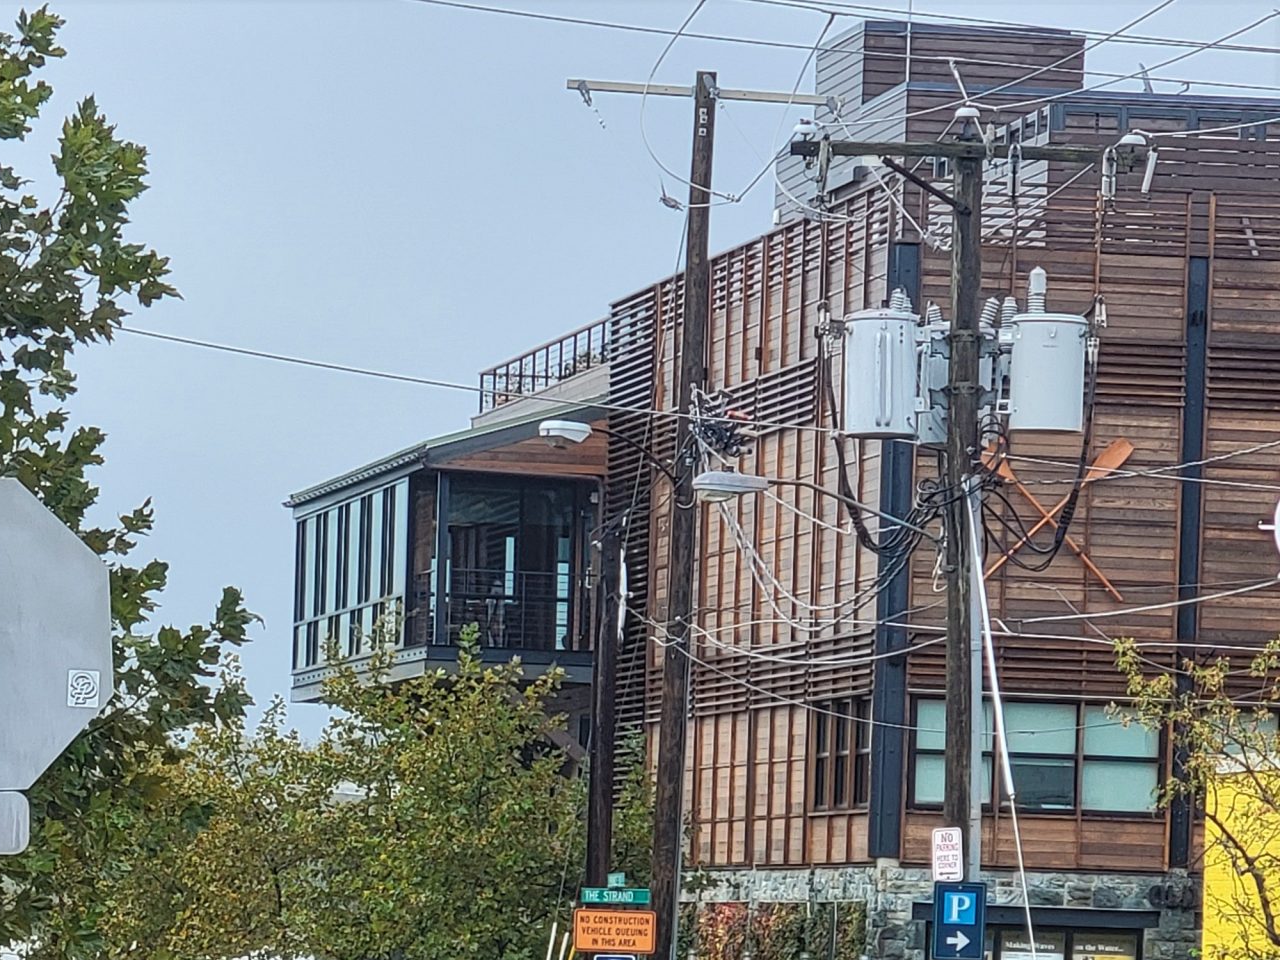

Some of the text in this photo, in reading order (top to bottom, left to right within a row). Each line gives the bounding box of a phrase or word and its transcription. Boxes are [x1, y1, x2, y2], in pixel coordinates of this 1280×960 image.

[941, 833, 954, 843] NO
[936, 843, 959, 851] PARKING
[584, 891, 634, 902] THE STRAND
[949, 894, 971, 922] P
[580, 916, 650, 925] NO CONSTRUCTION
[582, 926, 649, 937] VEHICLE QUEUING
[591, 938, 637, 947] IN THIS AREA
